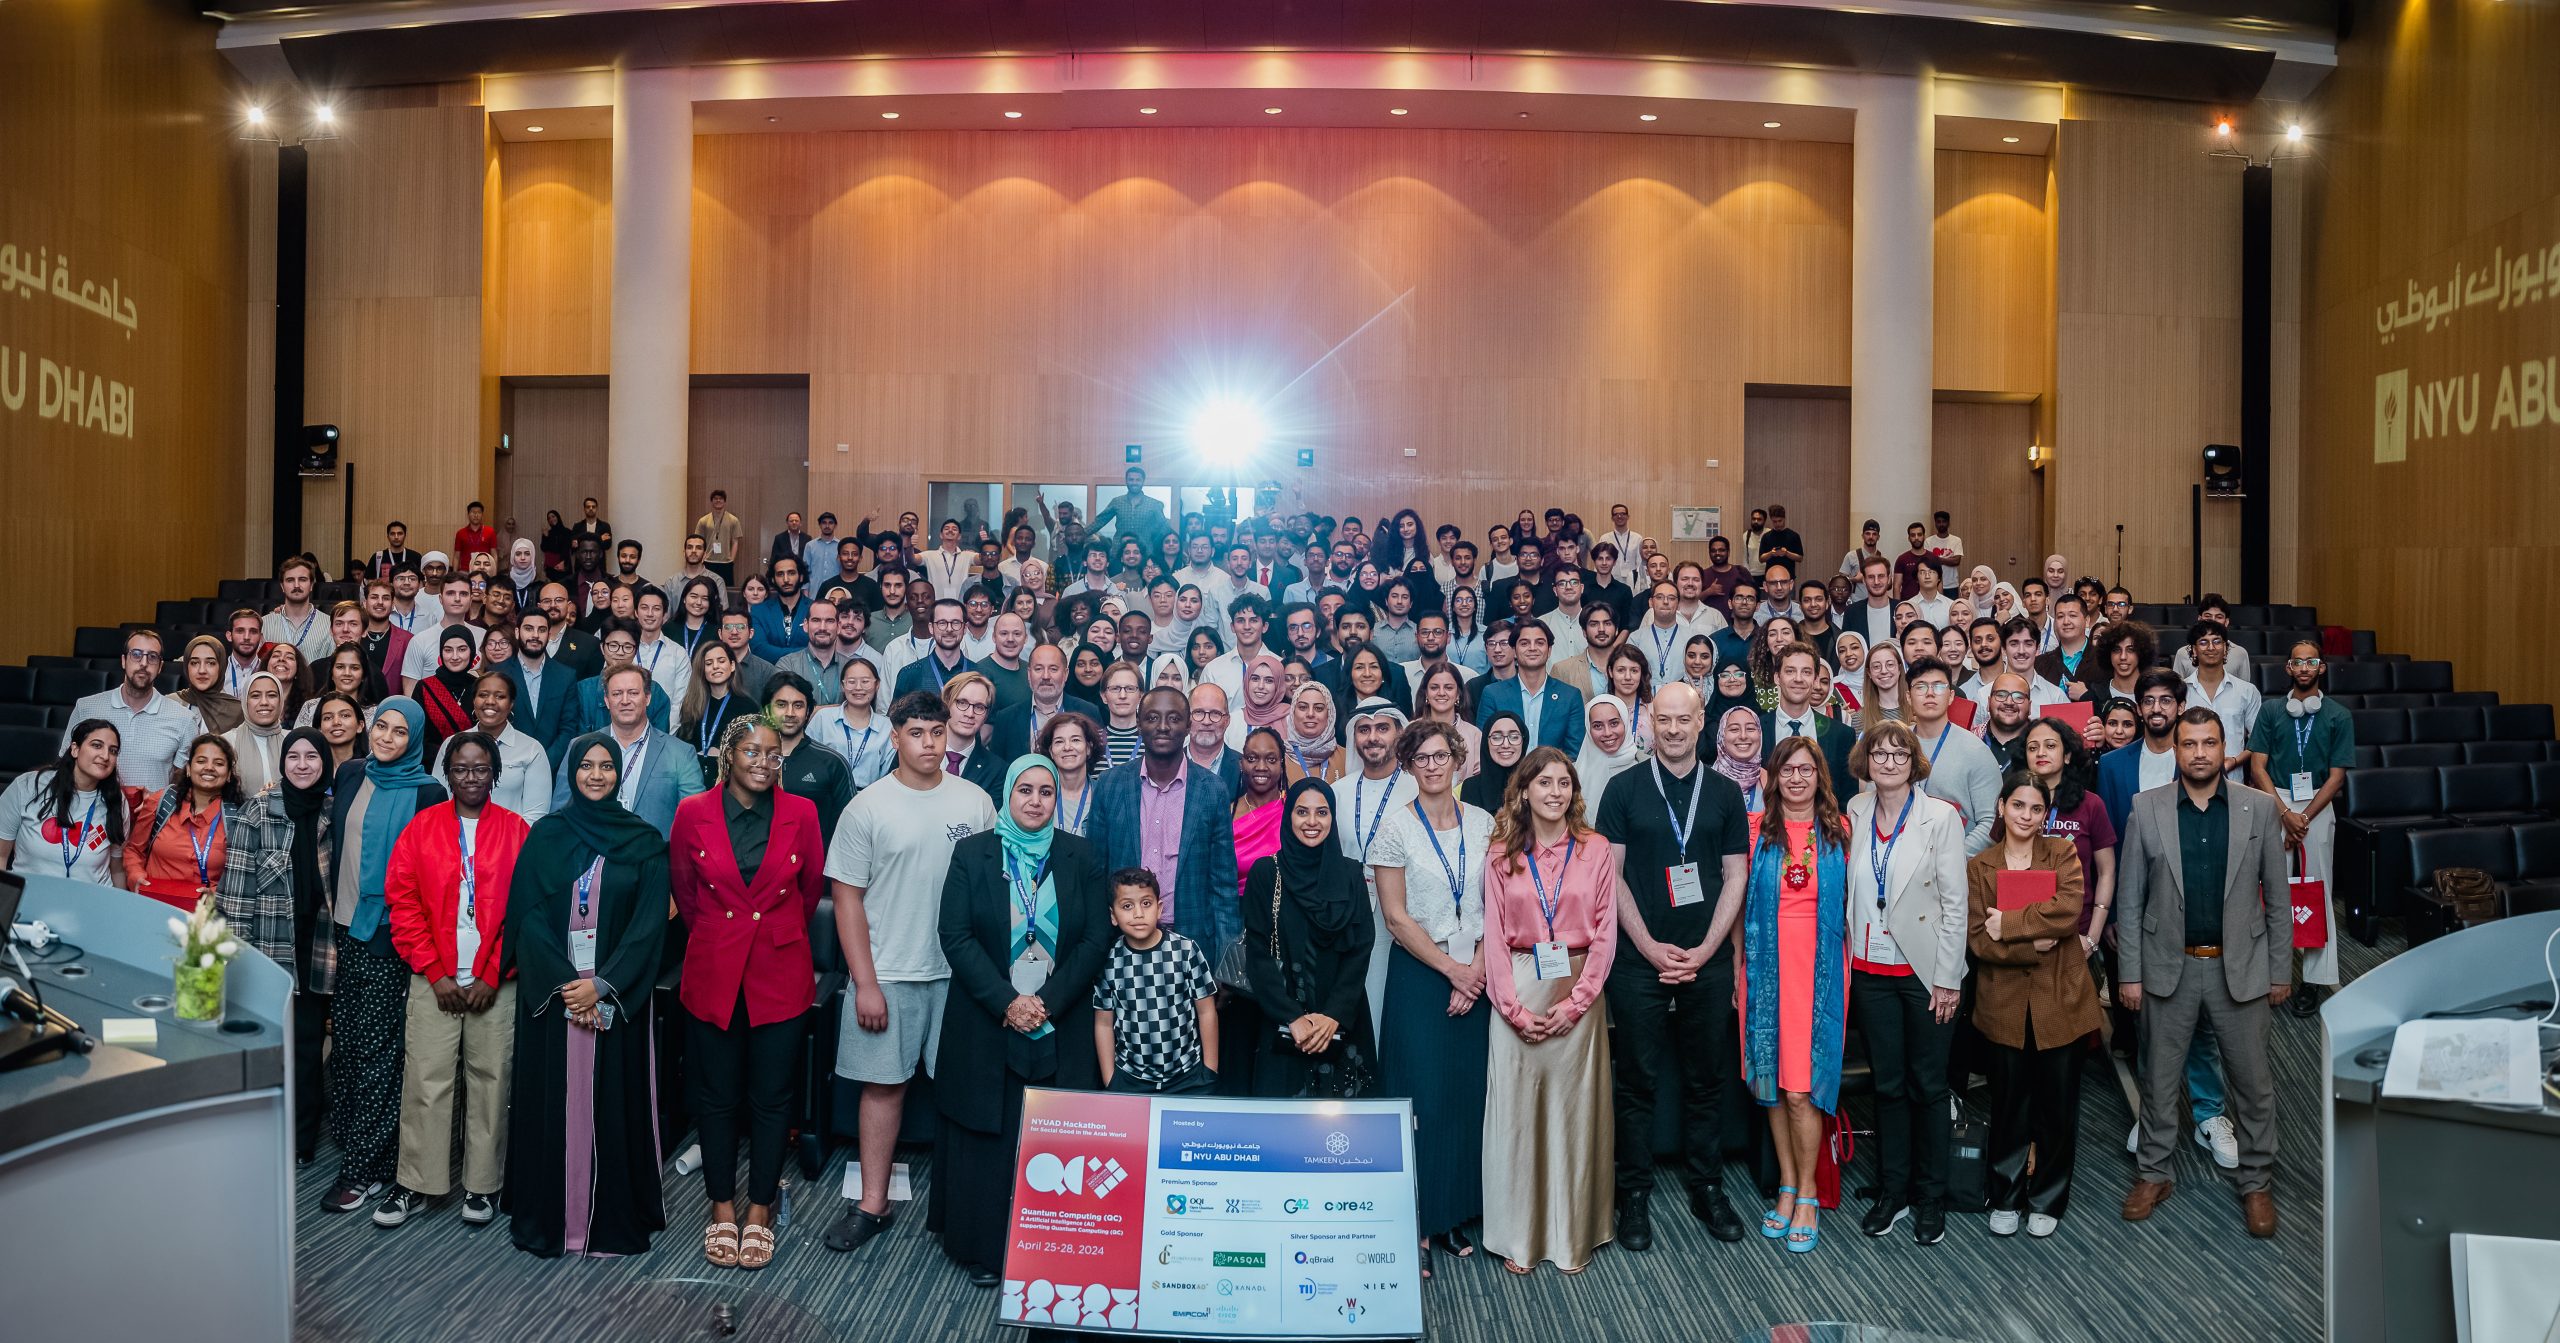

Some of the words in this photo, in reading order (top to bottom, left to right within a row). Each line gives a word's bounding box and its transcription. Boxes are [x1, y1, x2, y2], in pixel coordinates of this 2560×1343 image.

[52, 254, 138, 341] جامعة
[38, 357, 134, 440] DHABI
[2414, 372, 2480, 440] NYU
[1032, 1118, 1061, 1126] NYUAD
[1064, 1120, 1106, 1130] Hackathon
[1234, 1154, 1260, 1162] DHABI
[1304, 1156, 1338, 1164] TAMKEEN
[1284, 1198, 1309, 1214] G42
[1021, 1208, 1056, 1217] Quantum
[1059, 1211, 1102, 1221] Computing
[1104, 1214, 1122, 1222] (QC)
[1020, 1223, 1050, 1231] supporting
[1017, 1240, 1041, 1251] April
[1044, 1242, 1075, 1254] 25-28,
[1079, 1245, 1104, 1255] 2024
[1227, 1256, 1264, 1264] PASQAL
[1310, 1256, 1334, 1264] qBraid
[1299, 1284, 1312, 1294] TII
